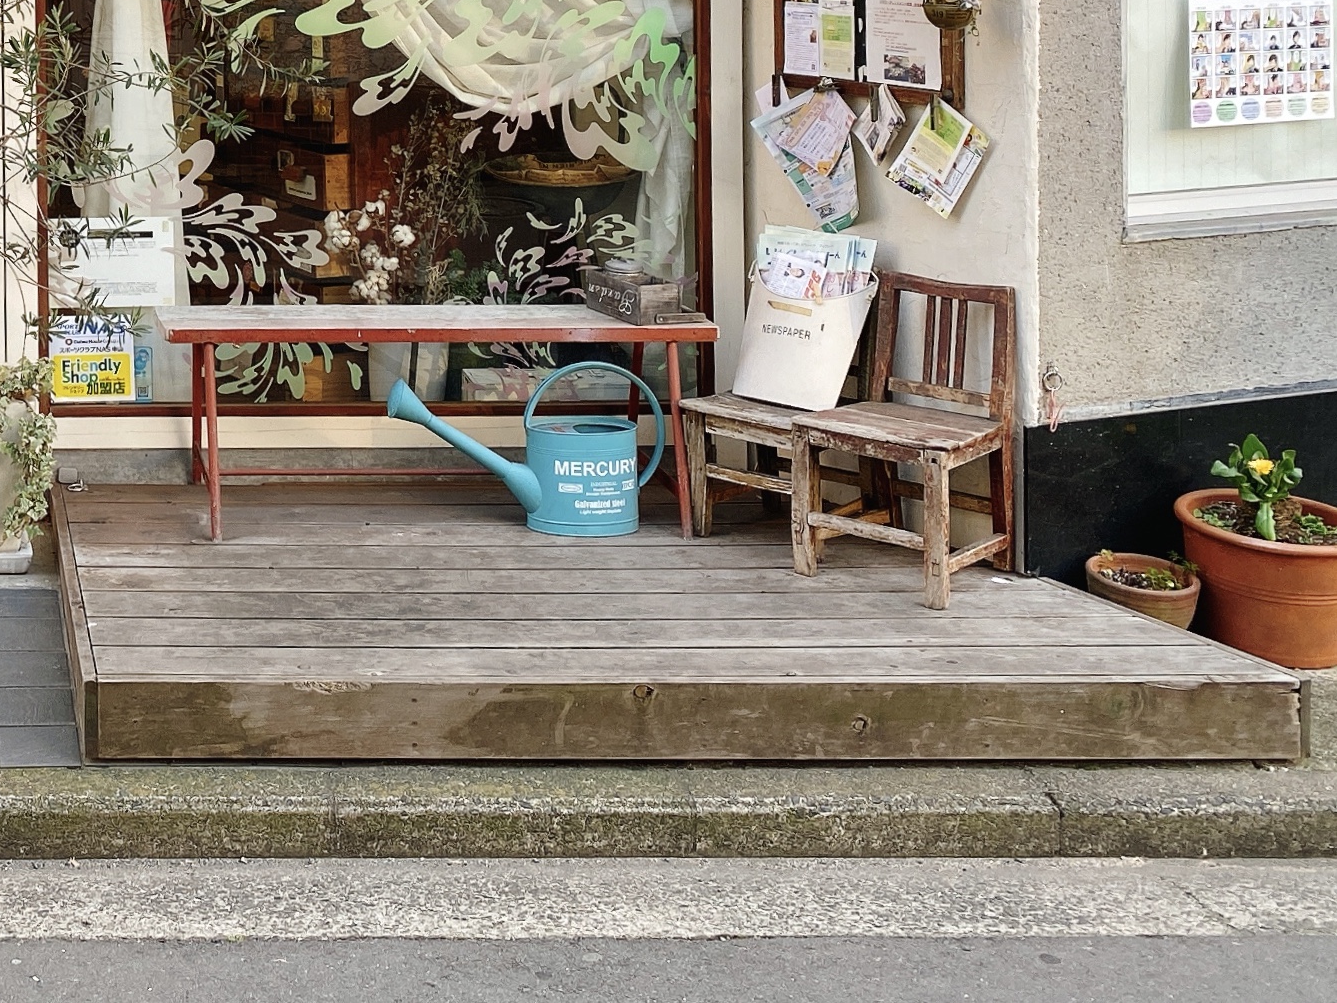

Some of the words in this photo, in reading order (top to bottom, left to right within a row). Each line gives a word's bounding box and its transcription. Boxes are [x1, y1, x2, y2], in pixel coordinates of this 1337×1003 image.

[762, 324, 811, 340] NEWSPAPER
[62, 358, 122, 375] Friendly
[62, 371, 98, 385] Shop
[87, 382, 125, 395] 加盟店
[554, 457, 637, 477] MERCURY
